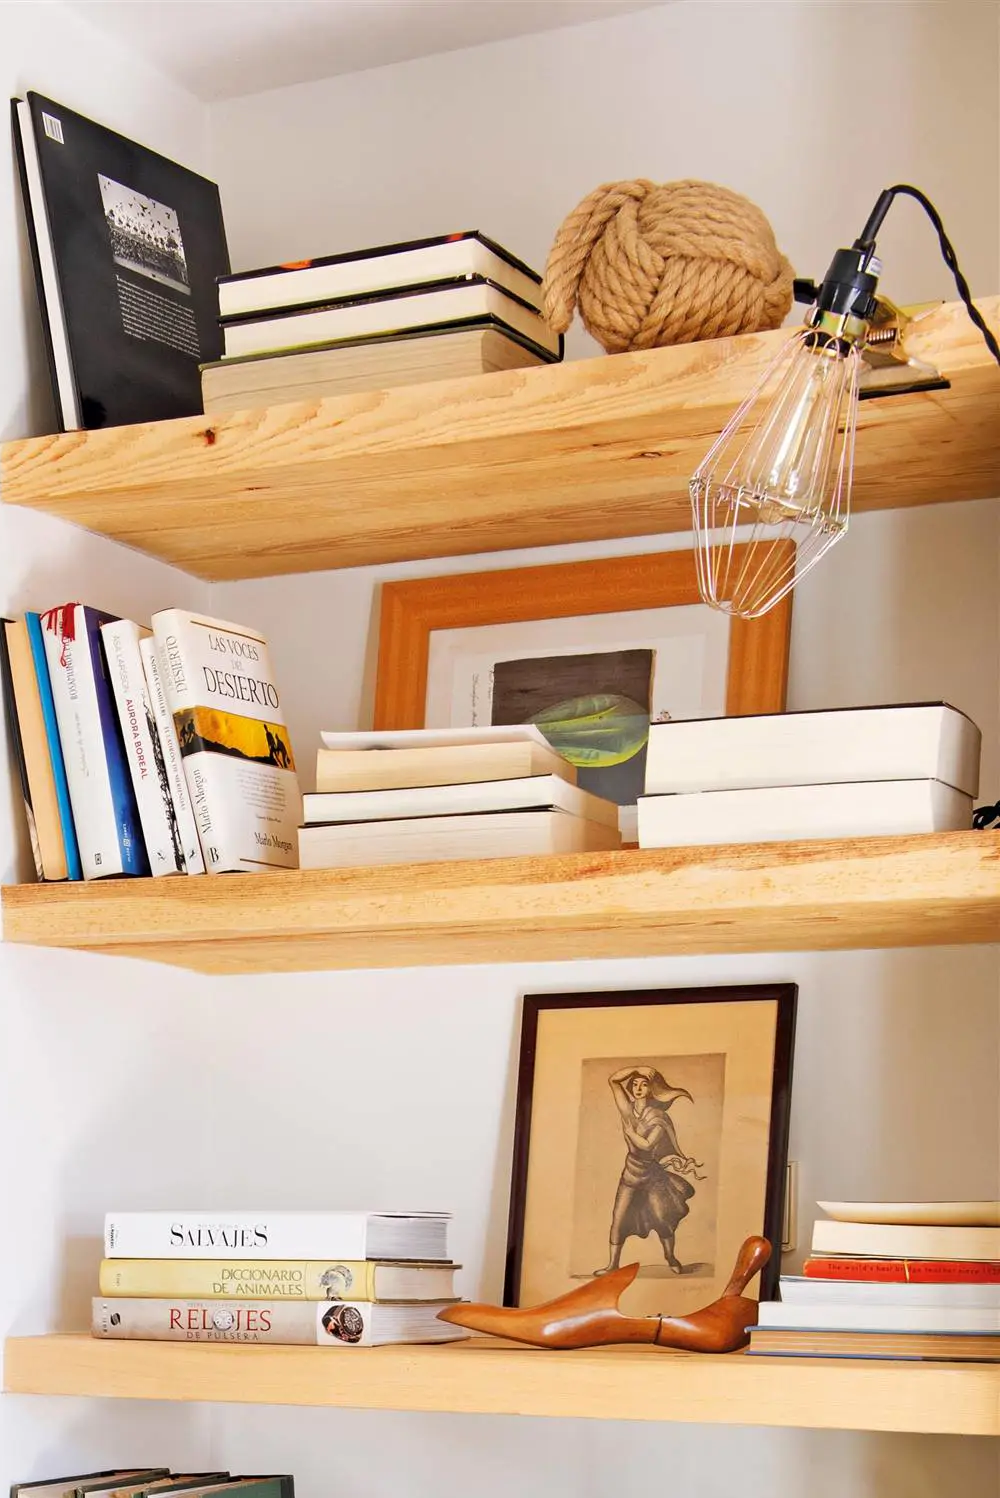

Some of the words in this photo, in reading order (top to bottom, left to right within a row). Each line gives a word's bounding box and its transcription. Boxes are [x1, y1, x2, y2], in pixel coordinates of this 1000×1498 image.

[208, 633, 226, 653] LAS
[226, 639, 259, 661] VOCES
[166, 635, 188, 693] DESIERTO
[203, 666, 279, 709] DESIERTO
[126, 699, 140, 740] AURORA
[134, 741, 149, 779] BOREAL
[193, 769, 208, 804] Morgan
[199, 805, 213, 834] Marlo
[209, 847, 220, 863] B
[221, 1268, 303, 1282] DICCIONARIO
[213, 1283, 228, 1294] DE
[235, 1283, 303, 1296] ANIMALES
[187, 1331, 200, 1339] DE
[207, 1332, 259, 1341] PULSERA
